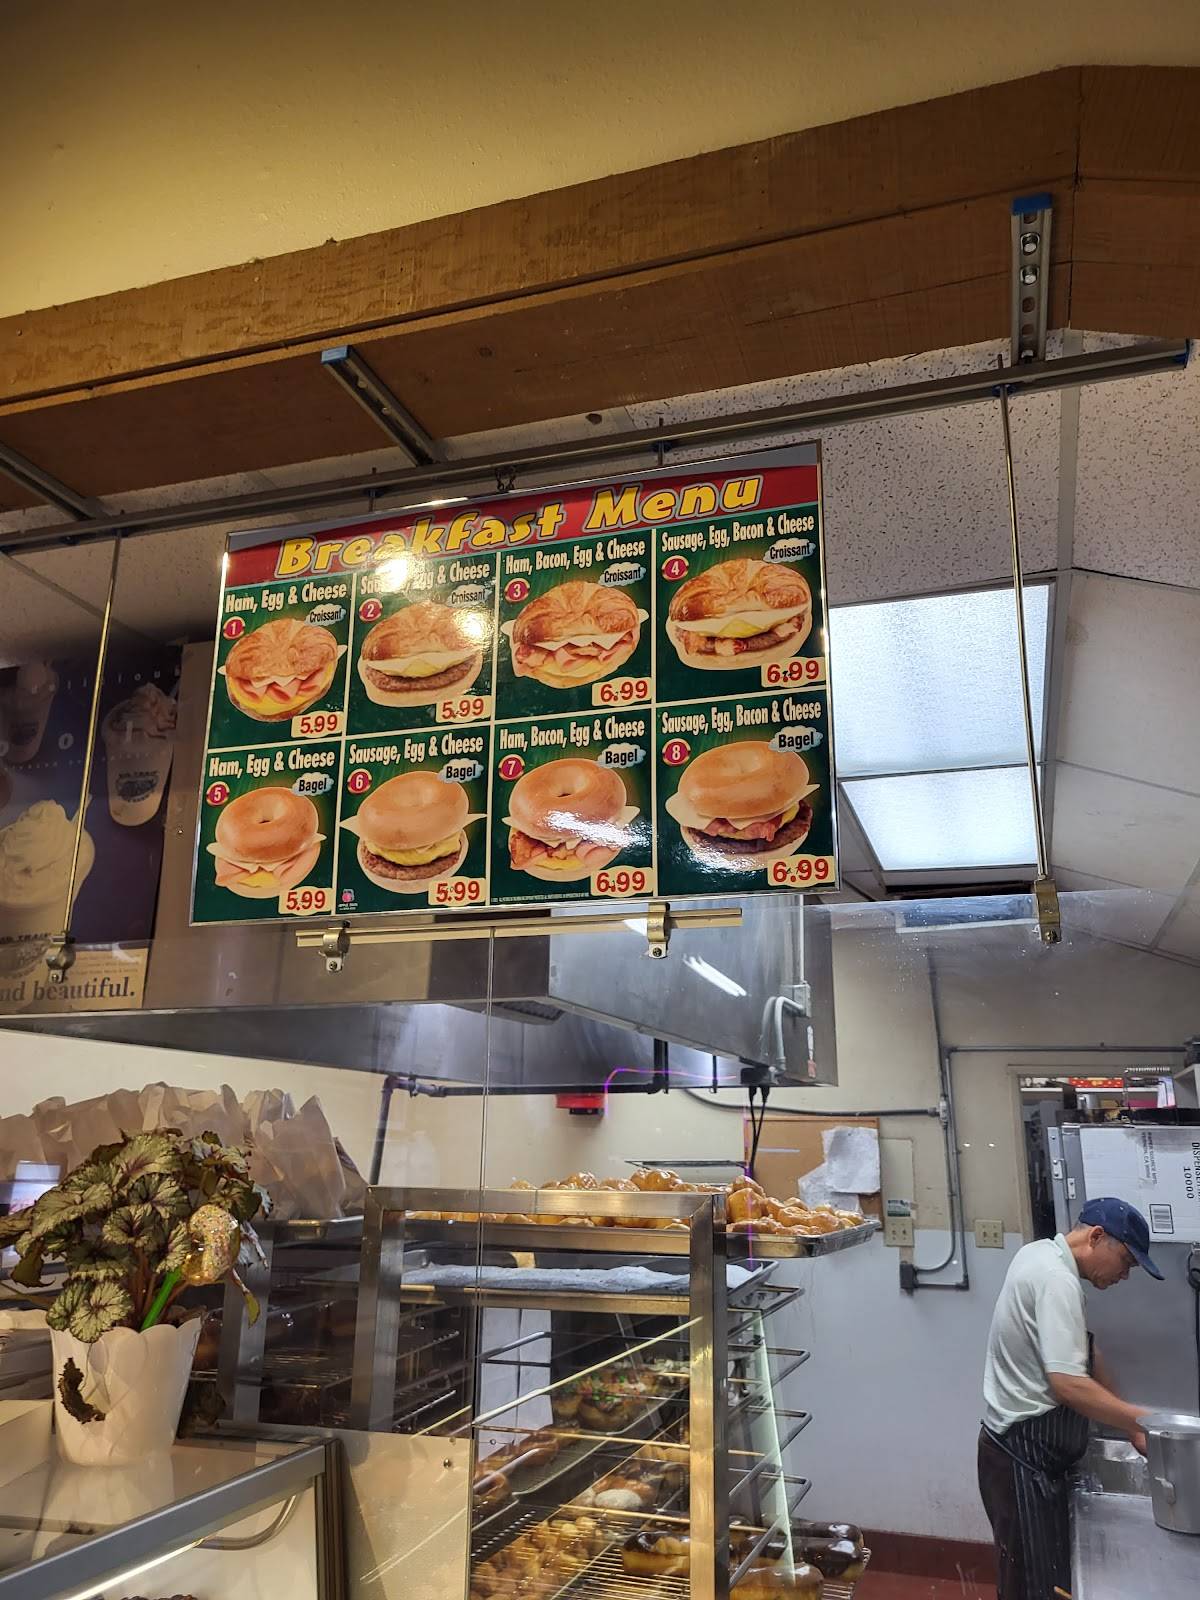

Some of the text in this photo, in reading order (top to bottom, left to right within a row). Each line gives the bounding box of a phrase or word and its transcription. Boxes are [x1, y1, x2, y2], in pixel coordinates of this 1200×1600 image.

[276, 476, 762, 577] Breakfast Menu
[662, 513, 814, 552] Sausage, Egg, Bacon & Cheese
[505, 538, 645, 575] Ham, Bacon, Egg & Cheese
[770, 543, 811, 560] Croissant
[438, 565, 447, 584] &
[450, 561, 490, 583] Cheese
[604, 567, 642, 583] Croissant
[671, 561, 679, 576] 4
[225, 582, 347, 613] Ham, Egg & Cheese
[451, 590, 486, 605] Croissant
[514, 583, 521, 598] 3
[309, 608, 343, 623] Croissant
[367, 605, 375, 617] 2
[230, 621, 237, 635] 1
[767, 660, 819, 684] 6.99
[600, 680, 648, 702] 6.99
[442, 698, 484, 720] 5.99
[662, 696, 821, 735] Sausage, Egg, Bacon & Cheese
[300, 714, 338, 734] 5.99
[500, 716, 645, 752] Ham, Bacon, Egg & Cheese
[349, 732, 484, 765] Sausage, Egg & Cheese
[778, 731, 814, 749] Bagel
[605, 748, 638, 765] Bagel
[672, 744, 681, 760] 8
[209, 748, 335, 779] Ham, Egg & Cheese
[446, 763, 476, 780] Bagel
[508, 760, 516, 775] 7
[298, 777, 327, 793] Bagel
[355, 774, 364, 789] 6
[214, 787, 222, 802] 5
[772, 858, 829, 883] 6.99
[435, 881, 480, 902] 5.99
[596, 871, 645, 893] 6.99
[286, 890, 326, 911] 5.99
[33, 977, 135, 1001] beautiful.
[1183, 1167, 1194, 1199] 10000
